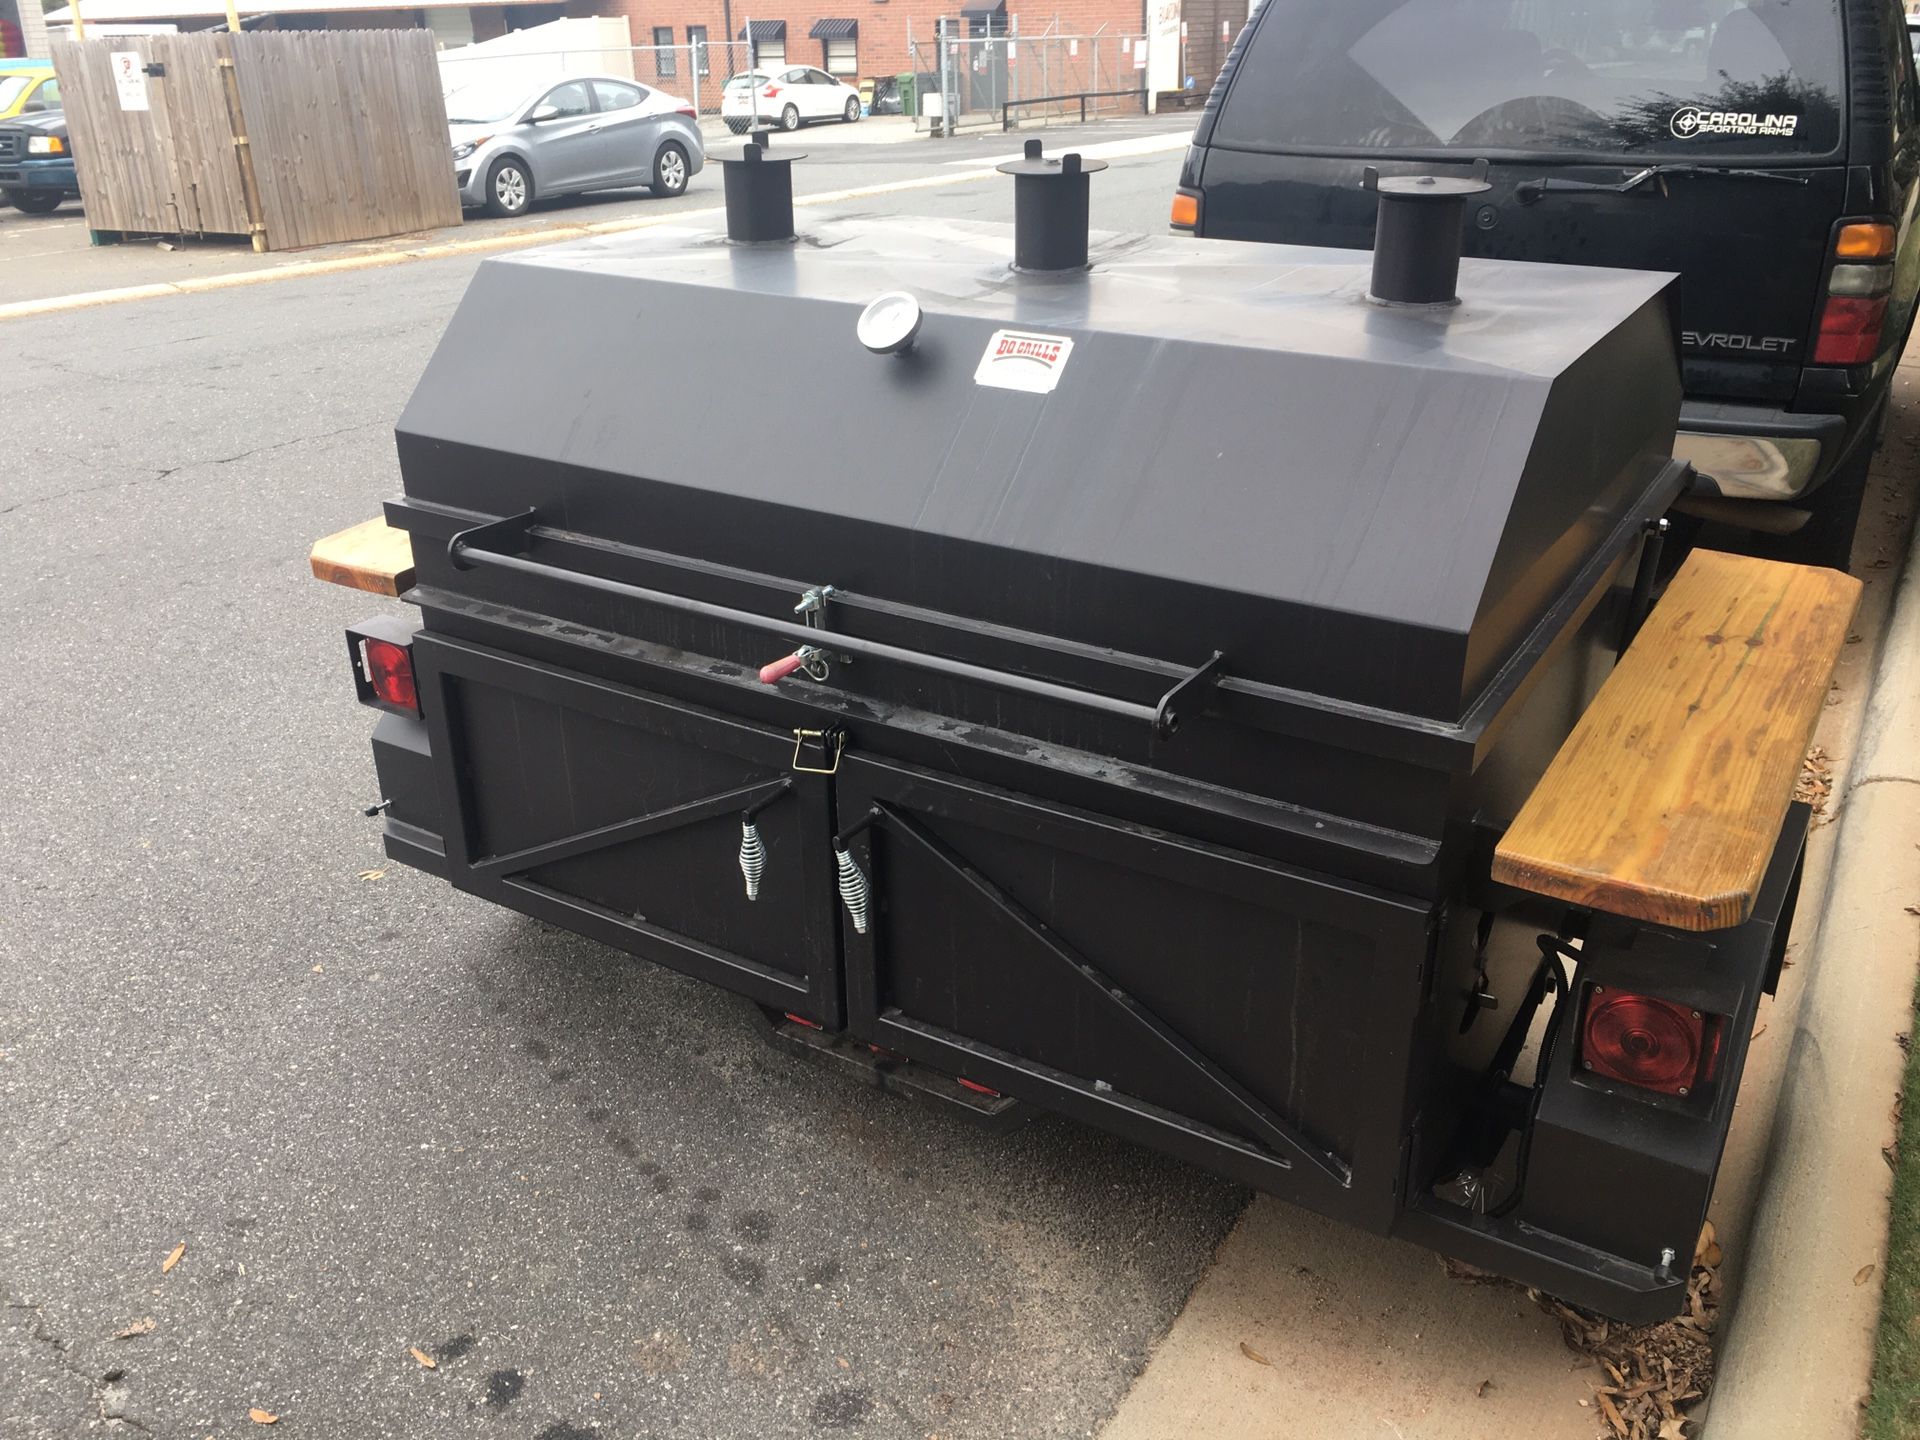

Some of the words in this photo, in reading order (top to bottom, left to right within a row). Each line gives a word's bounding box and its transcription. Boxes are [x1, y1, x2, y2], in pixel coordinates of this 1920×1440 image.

[1697, 111, 1798, 128] CAROLINA
[1699, 124, 1757, 135] SPORTING
[1758, 126, 1794, 137] ARMS
[1016, 341, 1061, 362] GRILLS
